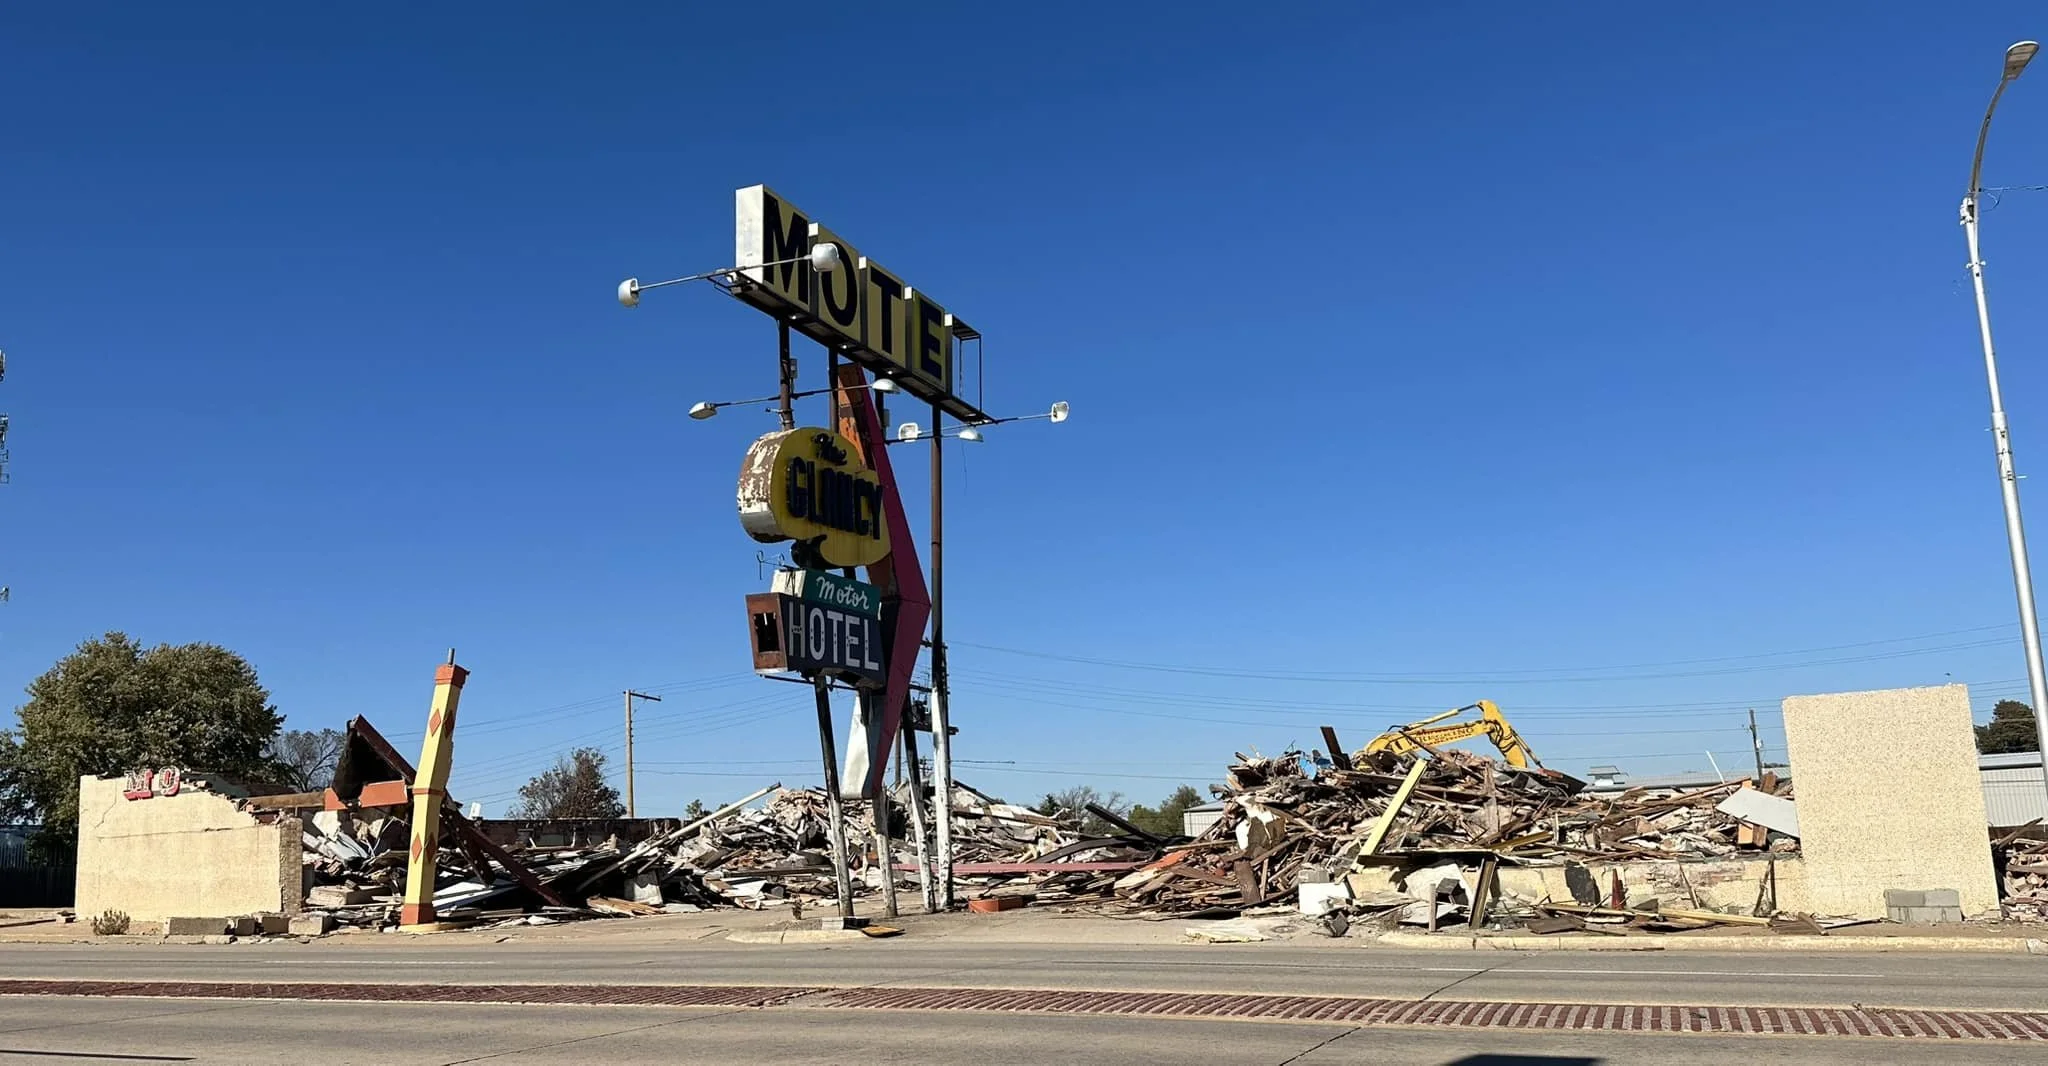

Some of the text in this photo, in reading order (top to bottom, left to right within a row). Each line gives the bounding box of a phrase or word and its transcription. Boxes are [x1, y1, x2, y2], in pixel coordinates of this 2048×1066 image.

[763, 191, 942, 380] MOTE
[815, 576, 870, 610] Motor
[788, 602, 880, 671] HOTEL
